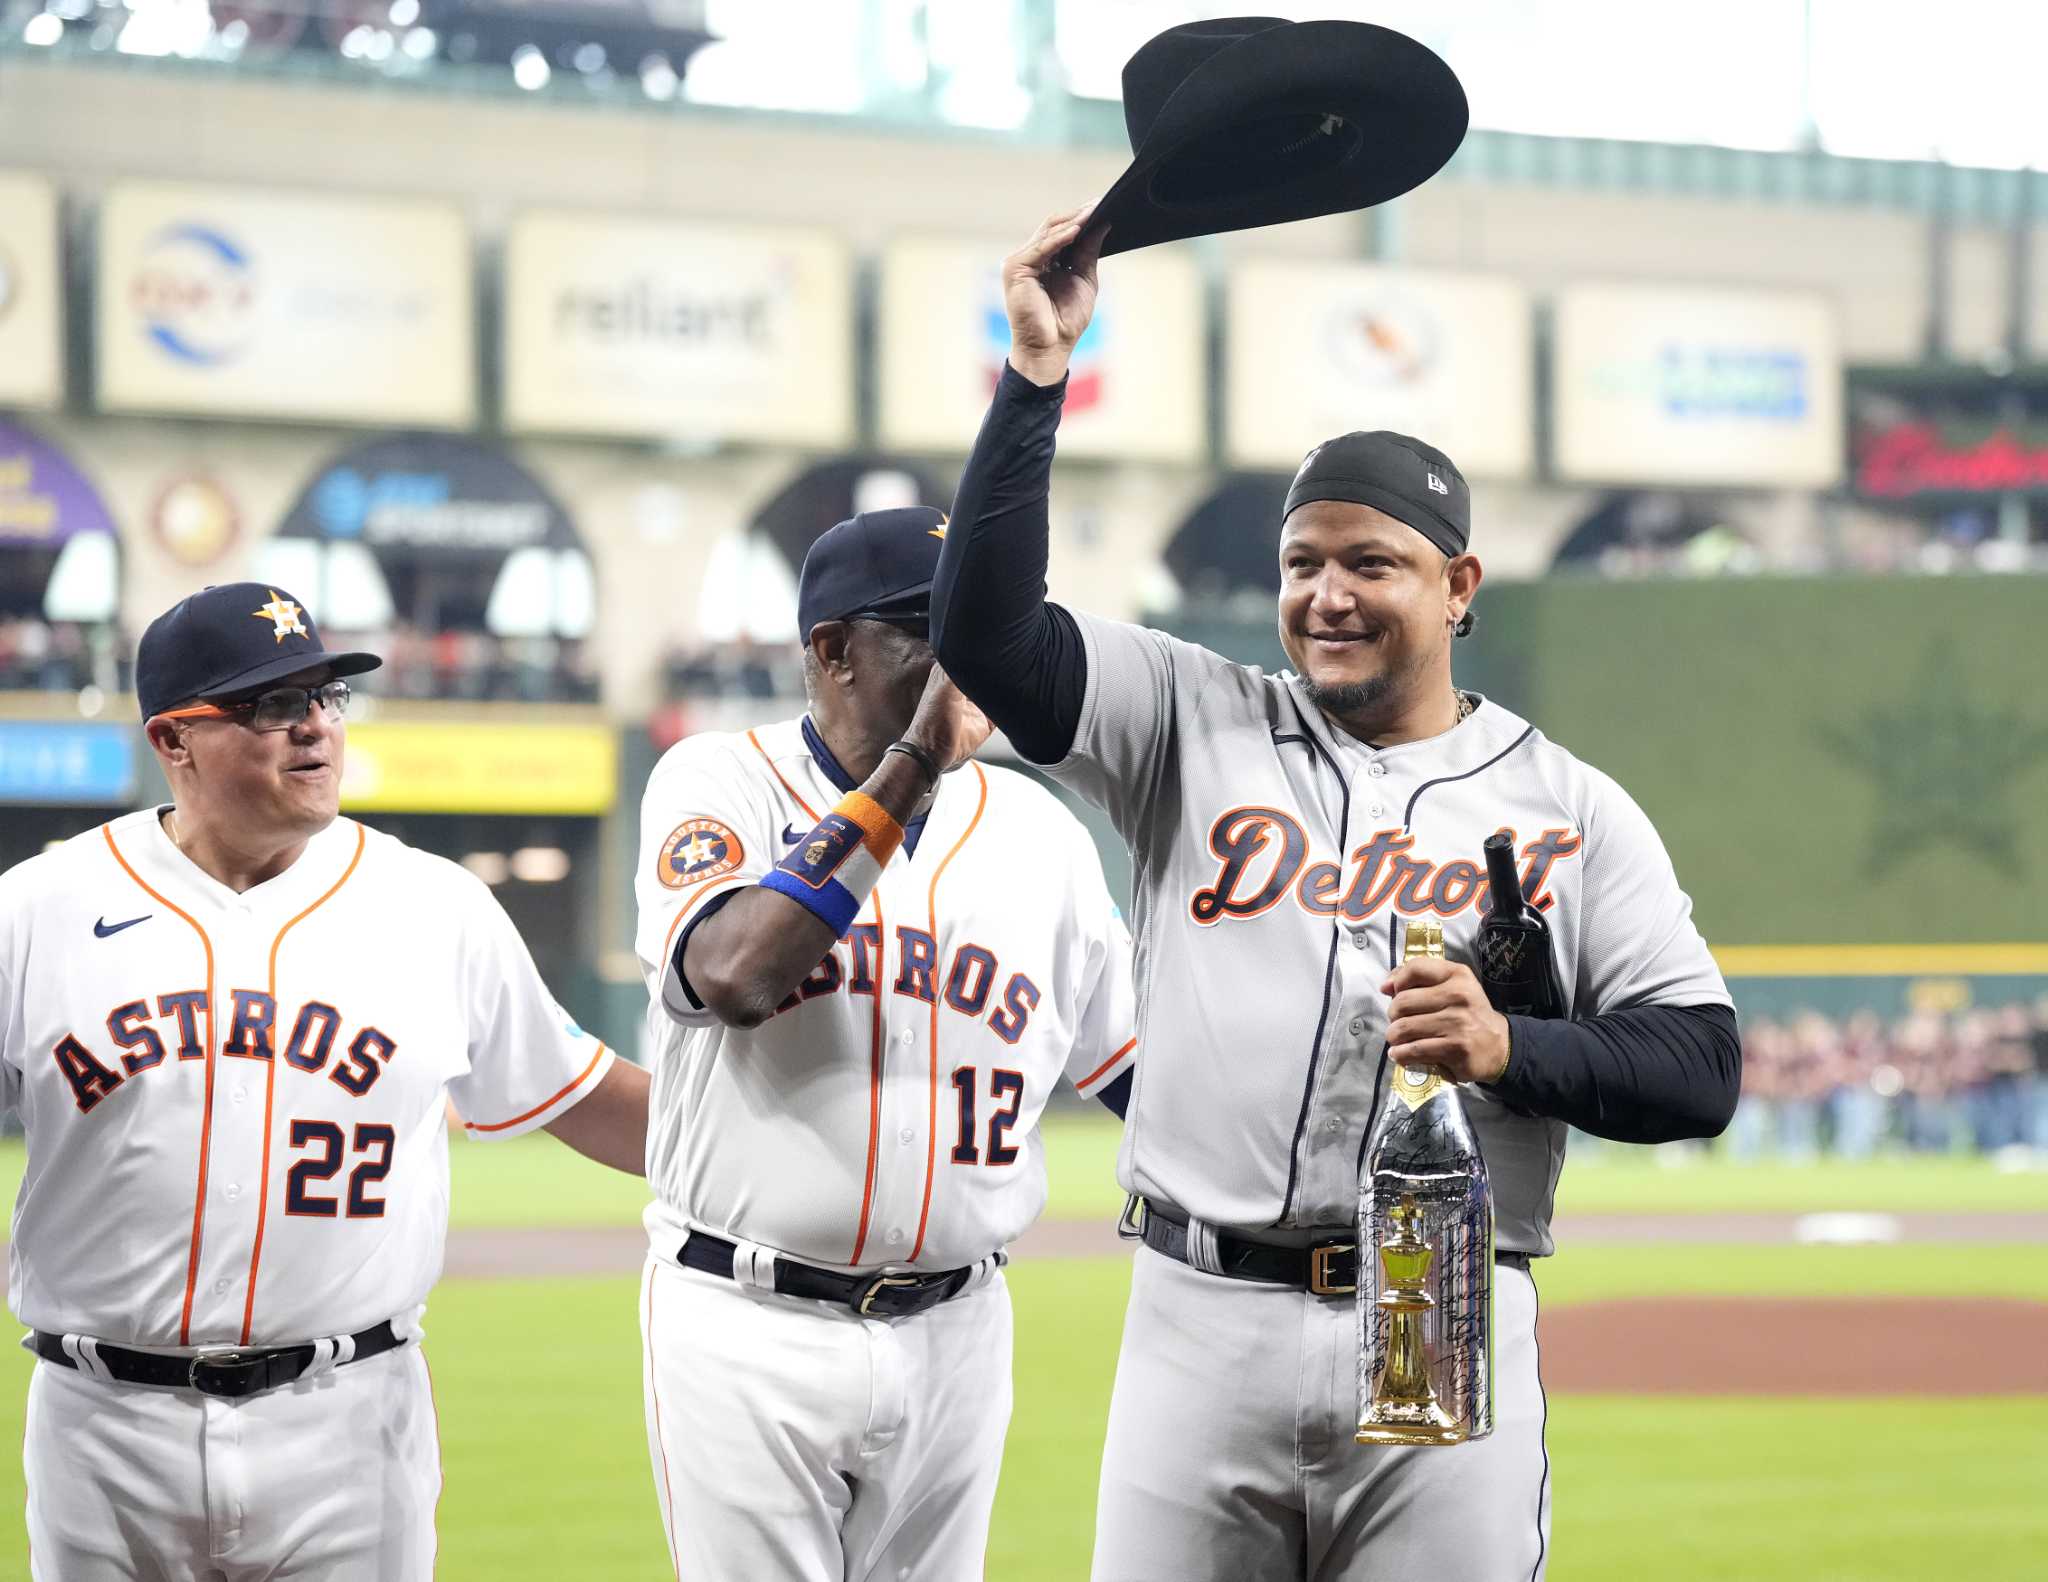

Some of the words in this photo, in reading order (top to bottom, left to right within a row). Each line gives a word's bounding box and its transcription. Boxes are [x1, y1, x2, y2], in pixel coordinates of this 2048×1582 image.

[663, 821, 732, 855] HOUSTON
[672, 860, 733, 886] ASTROS
[759, 923, 1041, 1044] TROS
[54, 988, 397, 1114] ASTROS
[951, 1065, 1024, 1166] 12
[285, 1119, 395, 1218] 22
